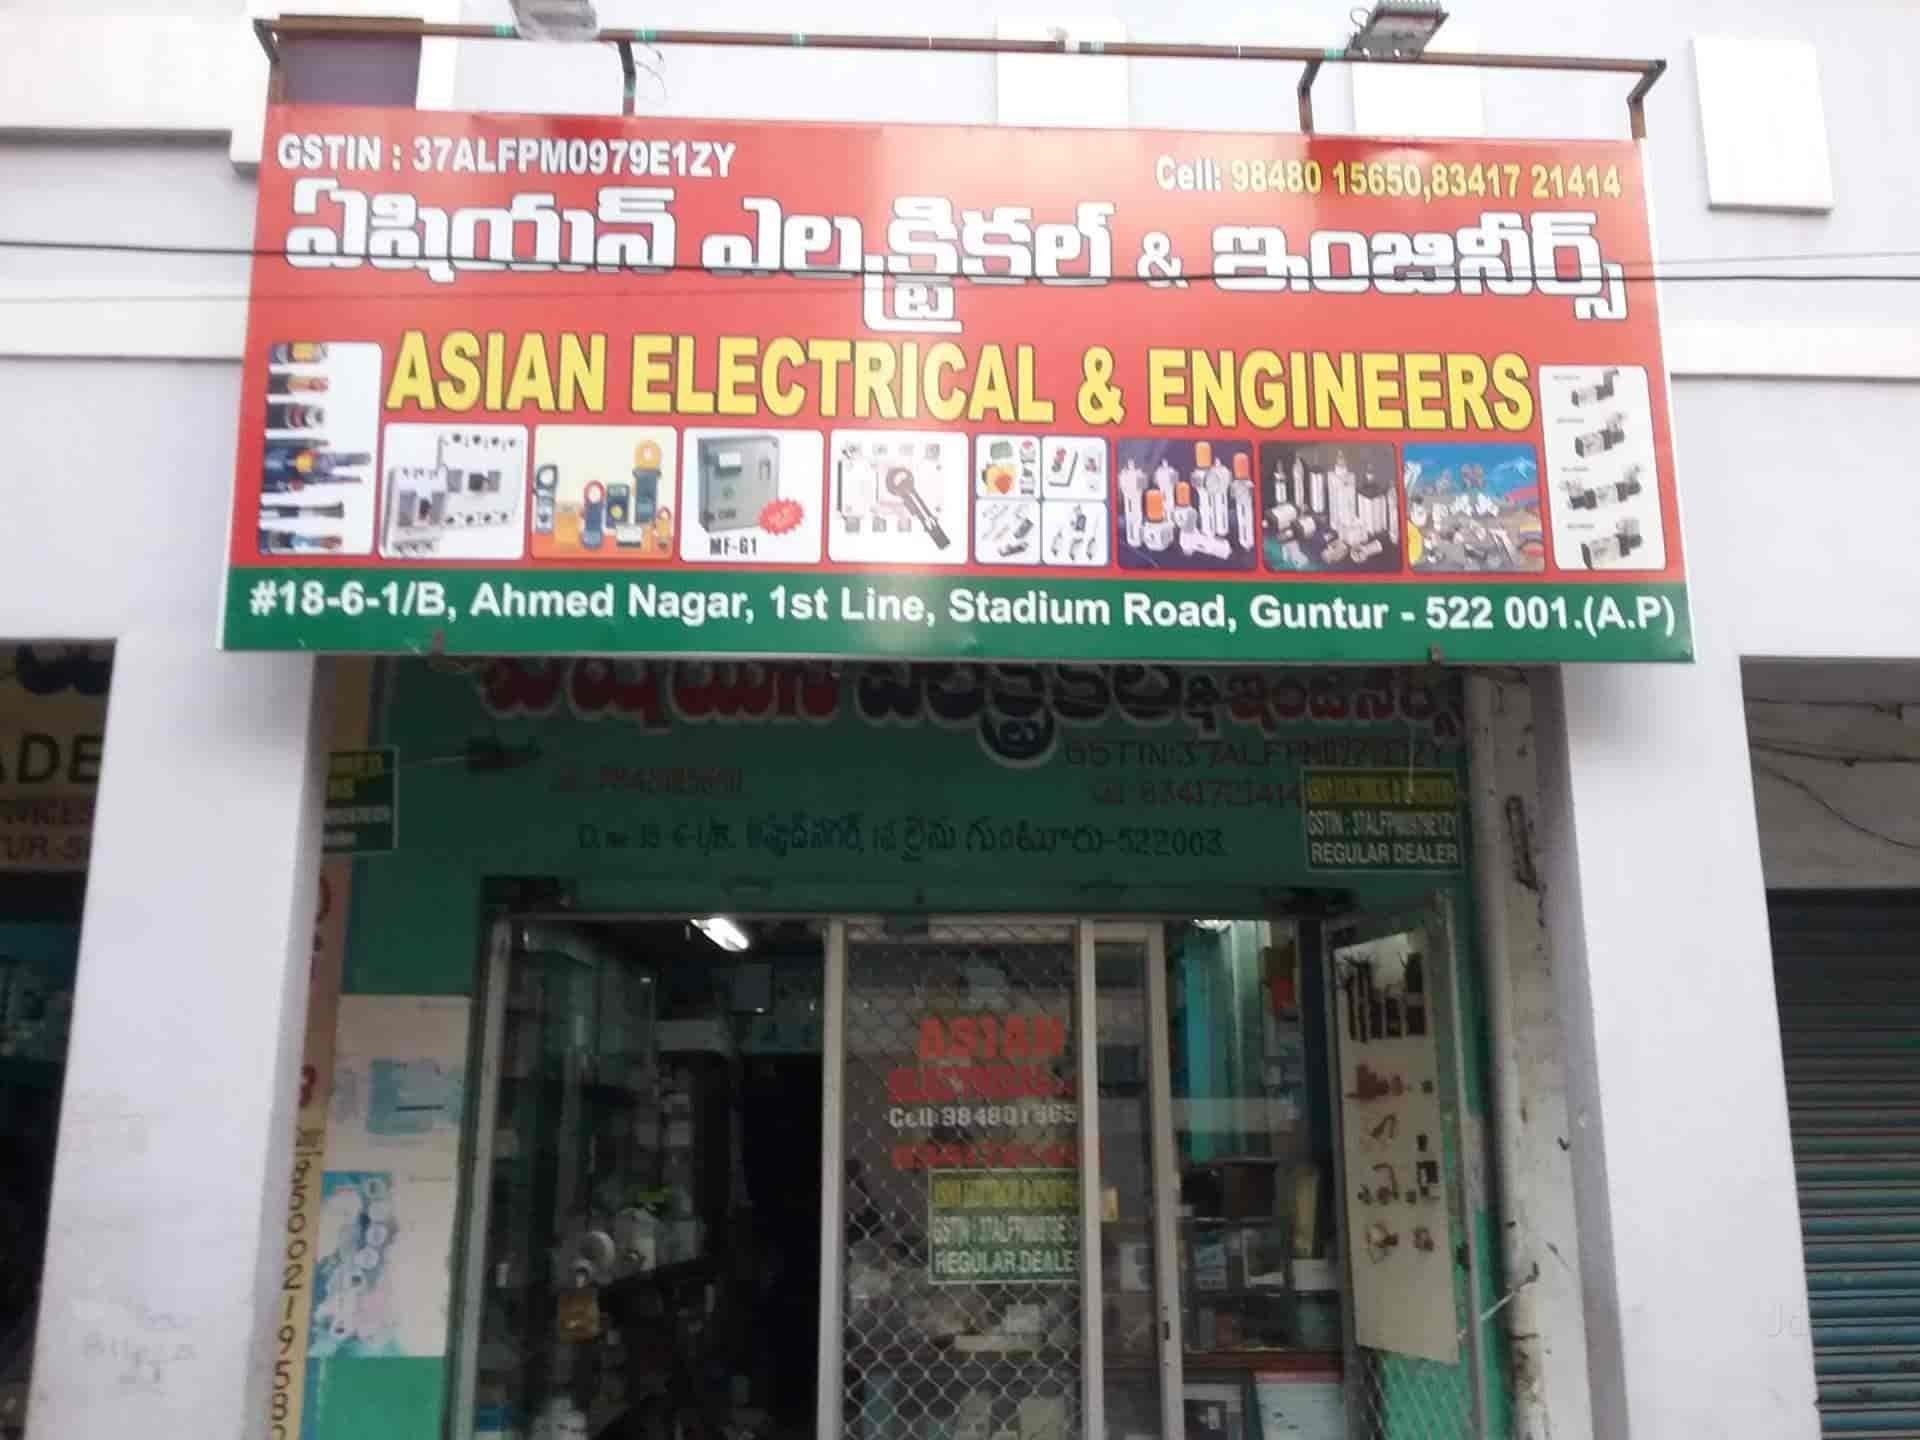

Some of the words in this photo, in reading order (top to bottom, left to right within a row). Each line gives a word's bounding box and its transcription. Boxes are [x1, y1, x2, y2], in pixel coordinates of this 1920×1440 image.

[277, 134, 382, 172] GSTIN
[411, 137, 736, 177] 37ALFPM0979E1ZY
[1154, 154, 1222, 194] Cell:
[1229, 158, 1322, 196] 98480
[1331, 160, 1521, 204] 15650,83417
[1530, 162, 1622, 202] 21414
[1134, 230, 1190, 290] &
[386, 331, 606, 412] ASIAN
[632, 335, 1055, 419] ELECTRICAL
[1077, 346, 1126, 424] &
[1149, 350, 1535, 430] ENGINEERS
[249, 583, 457, 623] #18-6-1/B,
[471, 582, 615, 620] Ahmed
[628, 584, 755, 626] Nagar,
[768, 584, 830, 622] 1st
[839, 584, 936, 626] Line,
[948, 588, 1110, 626] Stadium
[1123, 590, 1238, 634] Road,
[1250, 594, 1391, 629] Guntur
[1400, 612, 1416, 624] -
[1426, 598, 1494, 630] 522
[0, 733, 101, 784] DE
[1311, 843, 1390, 868] REGULAR
[1394, 843, 1457, 868] DEALER
[934, 1250, 1016, 1274] REGULAR
[1019, 1250, 1074, 1274] DEALE
